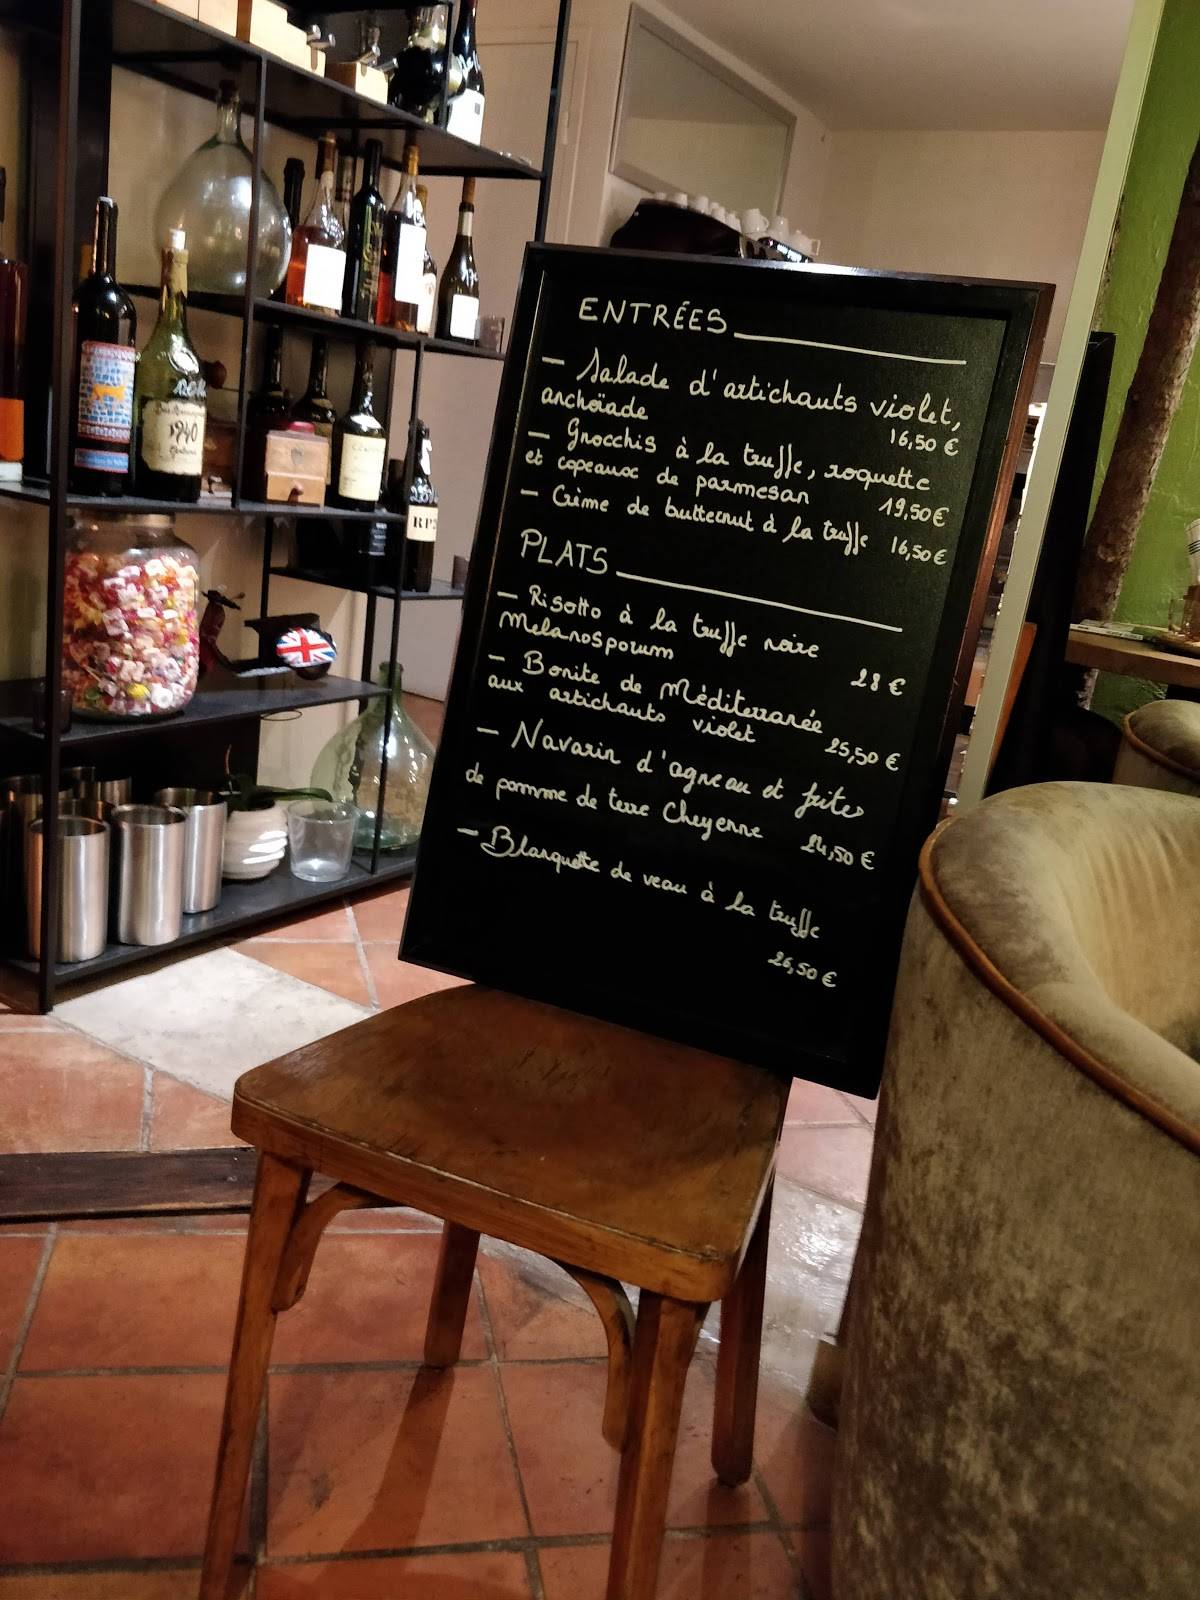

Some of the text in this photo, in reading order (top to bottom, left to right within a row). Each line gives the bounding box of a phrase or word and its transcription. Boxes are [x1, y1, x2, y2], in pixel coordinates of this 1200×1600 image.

[579, 298, 726, 333] ENTRÉES
[577, 348, 960, 431] Salade d'artichauts violet,
[526, 449, 542, 465] et
[558, 456, 638, 478] copeaux
[657, 467, 678, 485] de
[696, 475, 809, 504] parmesan
[676, 437, 689, 458] à
[696, 442, 729, 465] la
[824, 465, 930, 490] roquette
[891, 429, 936, 451] 16,50
[944, 438, 959, 456] €
[521, 529, 607, 574] PLATS
[553, 485, 609, 512] Crème
[627, 496, 649, 516] de
[665, 496, 754, 531] butternut
[763, 514, 777, 533] à
[782, 516, 813, 542] la
[823, 520, 868, 555] truffe
[499, 608, 905, 695] Melanosporum 28 €
[529, 585, 819, 657] Risotto à la truffe noire
[488, 675, 900, 771] aux artichauts violet 25,50 €
[523, 651, 822, 733] Bonite de Méditerranée
[512, 719, 864, 818] Navarin d'agneau et frites
[466, 763, 874, 870] de pomme de terre Cheyenne 24,50 €
[481, 826, 819, 938] Blanquette de veau à la truffe
[768, 952, 836, 987] 26,50 €
